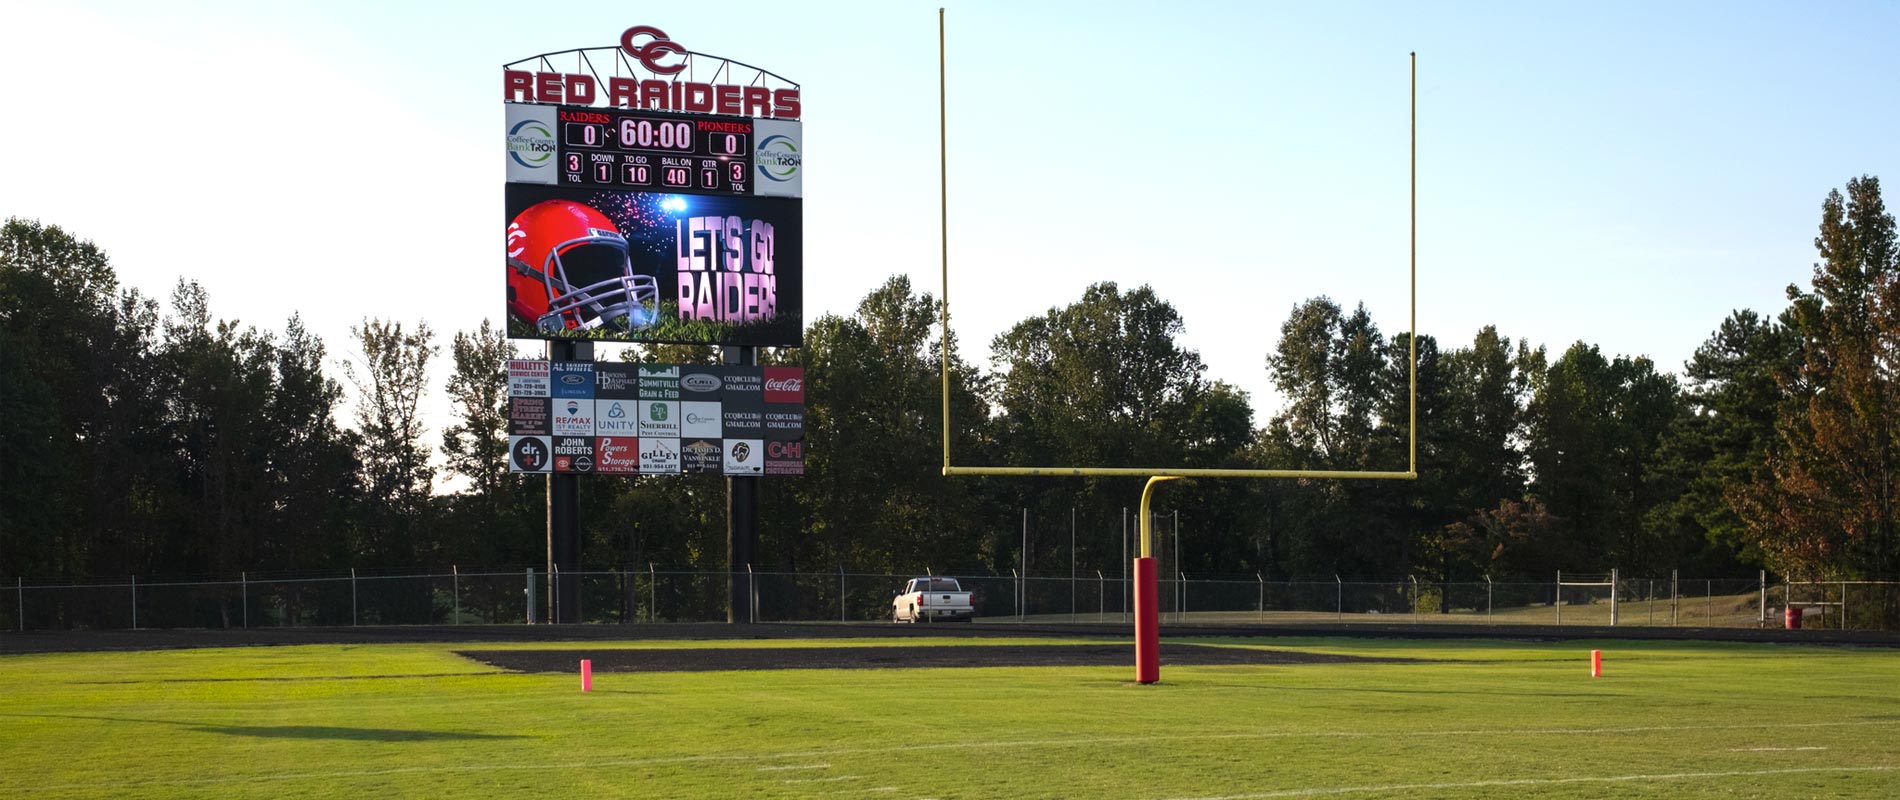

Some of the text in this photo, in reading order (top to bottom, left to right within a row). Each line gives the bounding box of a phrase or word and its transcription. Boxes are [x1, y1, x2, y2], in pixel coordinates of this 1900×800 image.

[504, 70, 801, 118] RED RAIDERS
[560, 111, 610, 124] RAIDERS
[698, 121, 752, 133] PIONEERS
[584, 125, 596, 145] 0
[621, 119, 691, 149] 60:00
[725, 134, 737, 154] 0
[569, 155, 579, 171] 3
[591, 154, 614, 162] DOWN
[624, 155, 647, 164] TO GO
[662, 157, 692, 167] BALL ON
[702, 160, 717, 168] QTR
[600, 165, 607, 180] 1
[628, 167, 647, 183] 10
[667, 169, 686, 185] 40
[733, 164, 742, 180] 3
[568, 174, 581, 183] TOL
[705, 171, 712, 186] 1
[731, 183, 745, 192] TOL
[676, 216, 774, 274] LET'S GO
[677, 272, 776, 323] RAIDERS
[510, 361, 549, 371] HULLETT'S
[552, 363, 593, 372] AL WHITE
[599, 421, 634, 429] UNITY
[561, 438, 585, 446] JOHN
[555, 446, 592, 455] ROBERTS
[641, 450, 678, 460] GILLEY
